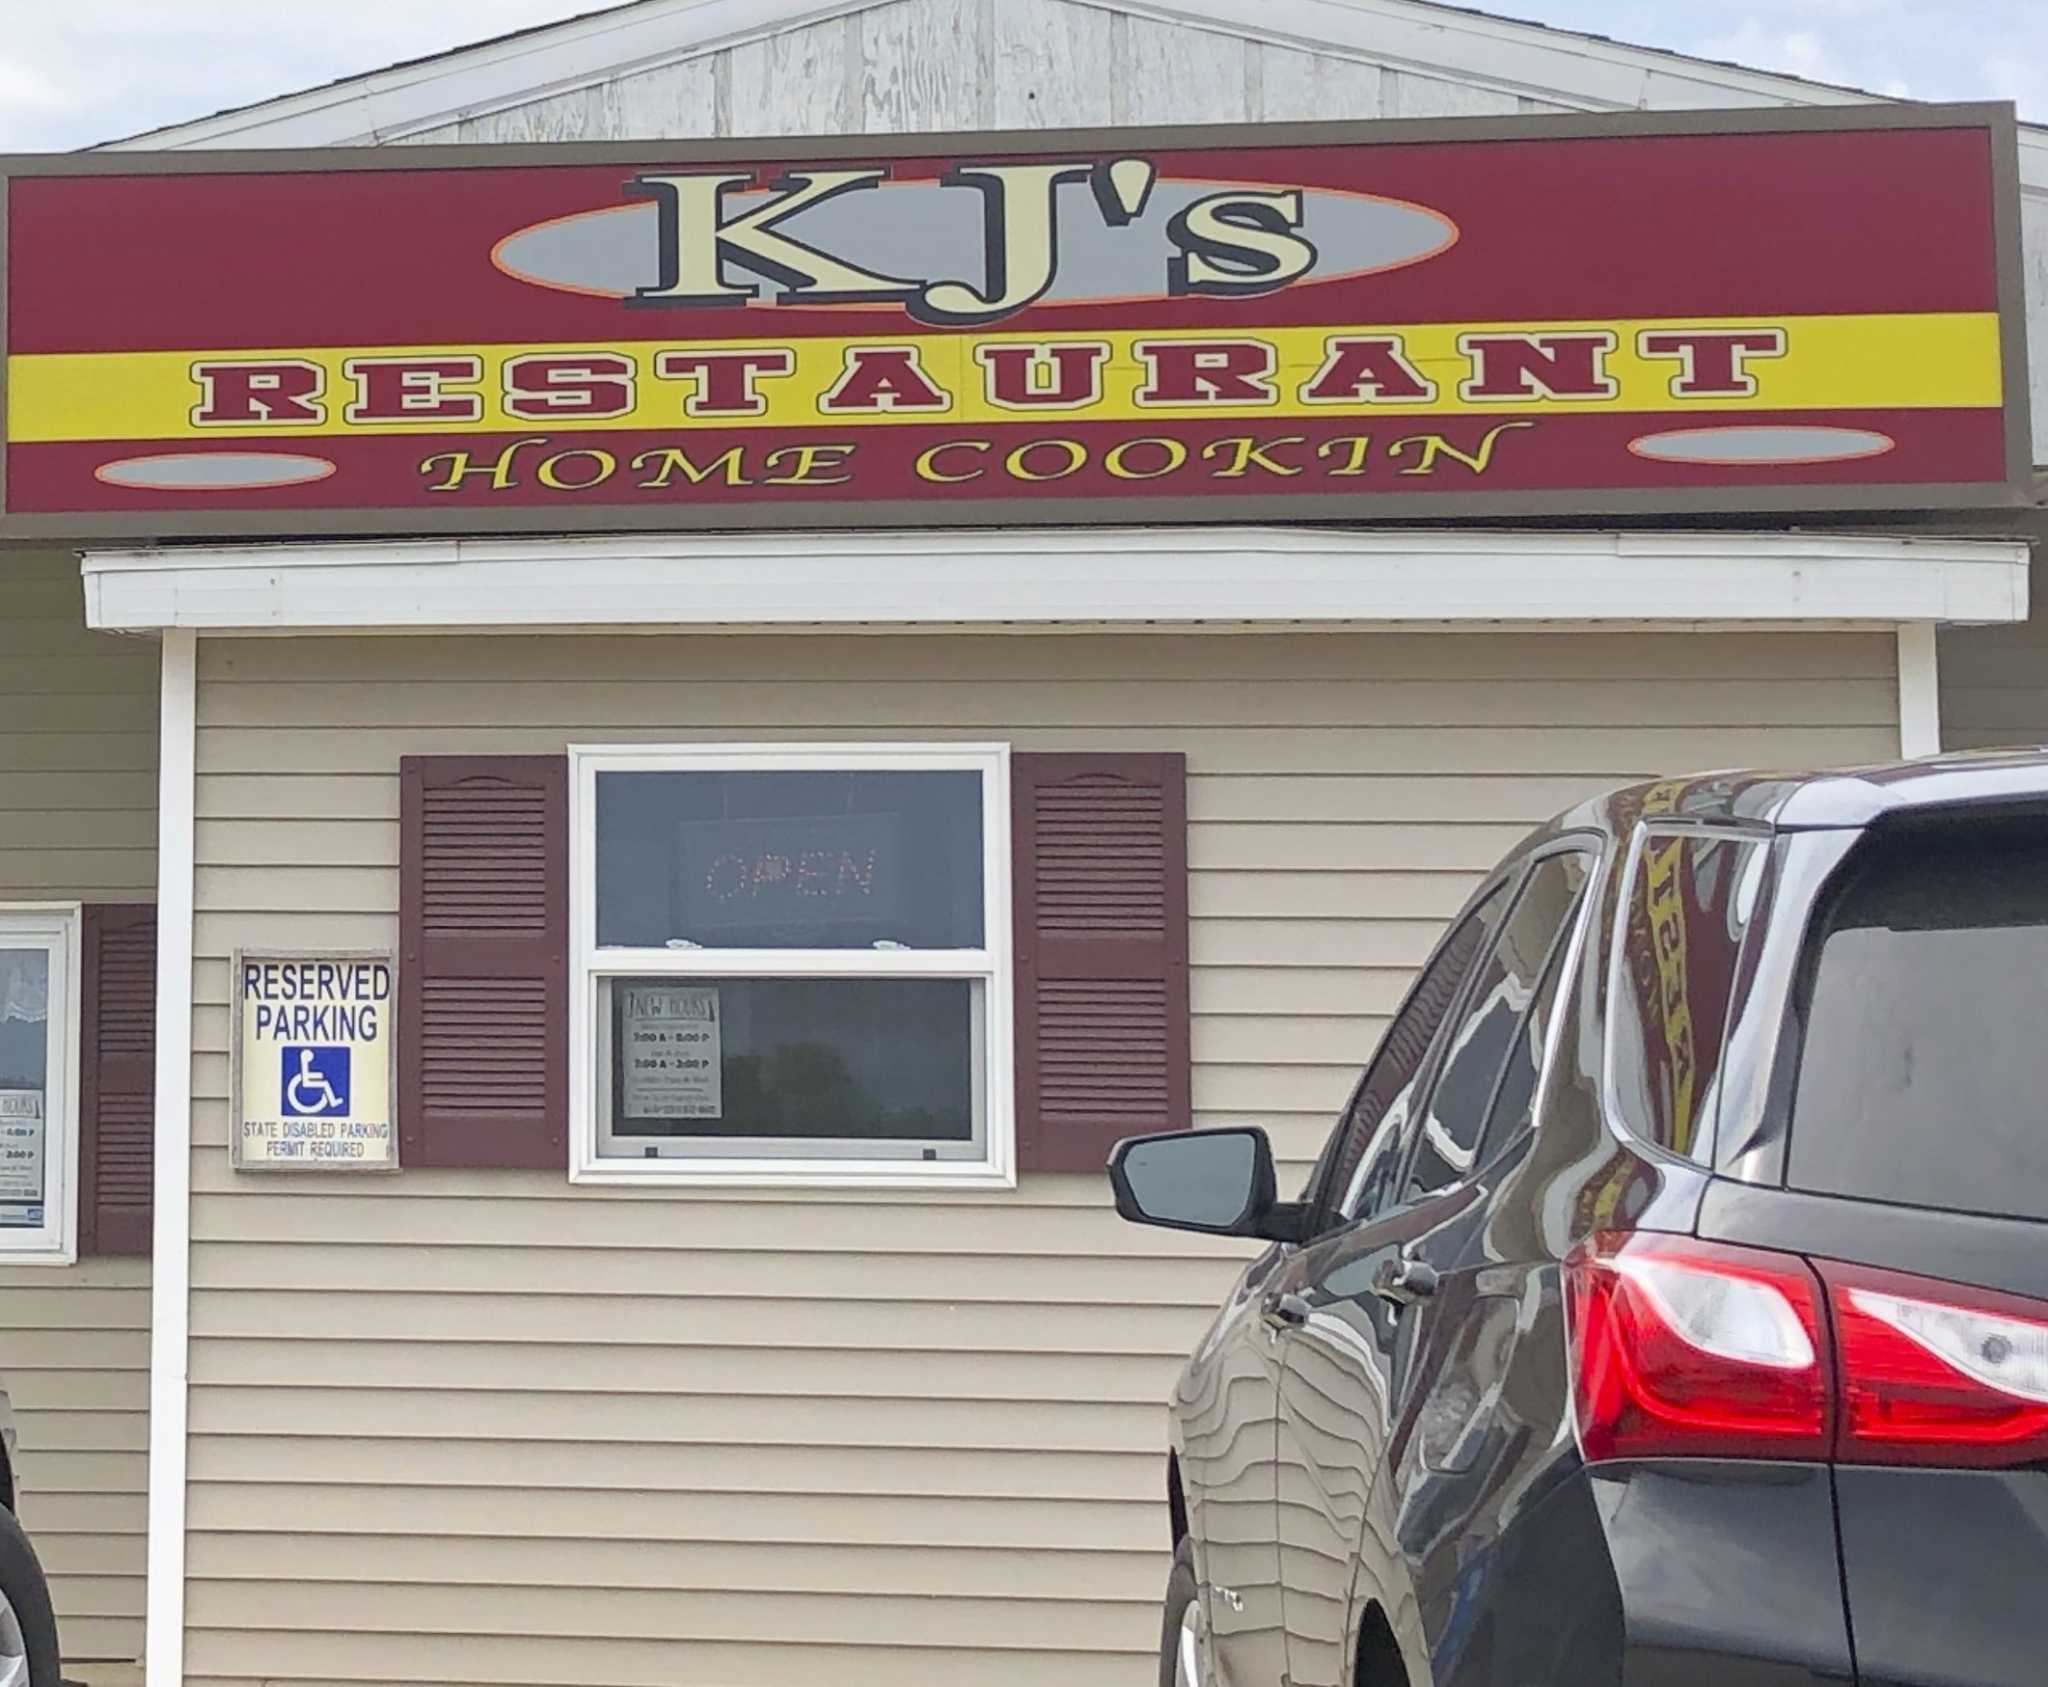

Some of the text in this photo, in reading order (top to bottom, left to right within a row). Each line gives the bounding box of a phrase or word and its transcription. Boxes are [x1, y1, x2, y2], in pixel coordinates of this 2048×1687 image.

[623, 158, 1318, 325] KJ's
[189, 327, 1787, 428] RESTAURANT
[419, 420, 1537, 492] HOME COOKIN
[705, 848, 876, 899] OPEN
[244, 964, 391, 1001] RESERVED
[256, 1004, 378, 1042] PARKING
[243, 1121, 389, 1139] STATE DISABLED PARKING
[266, 1140, 365, 1158] PERMIT REQUIRED
